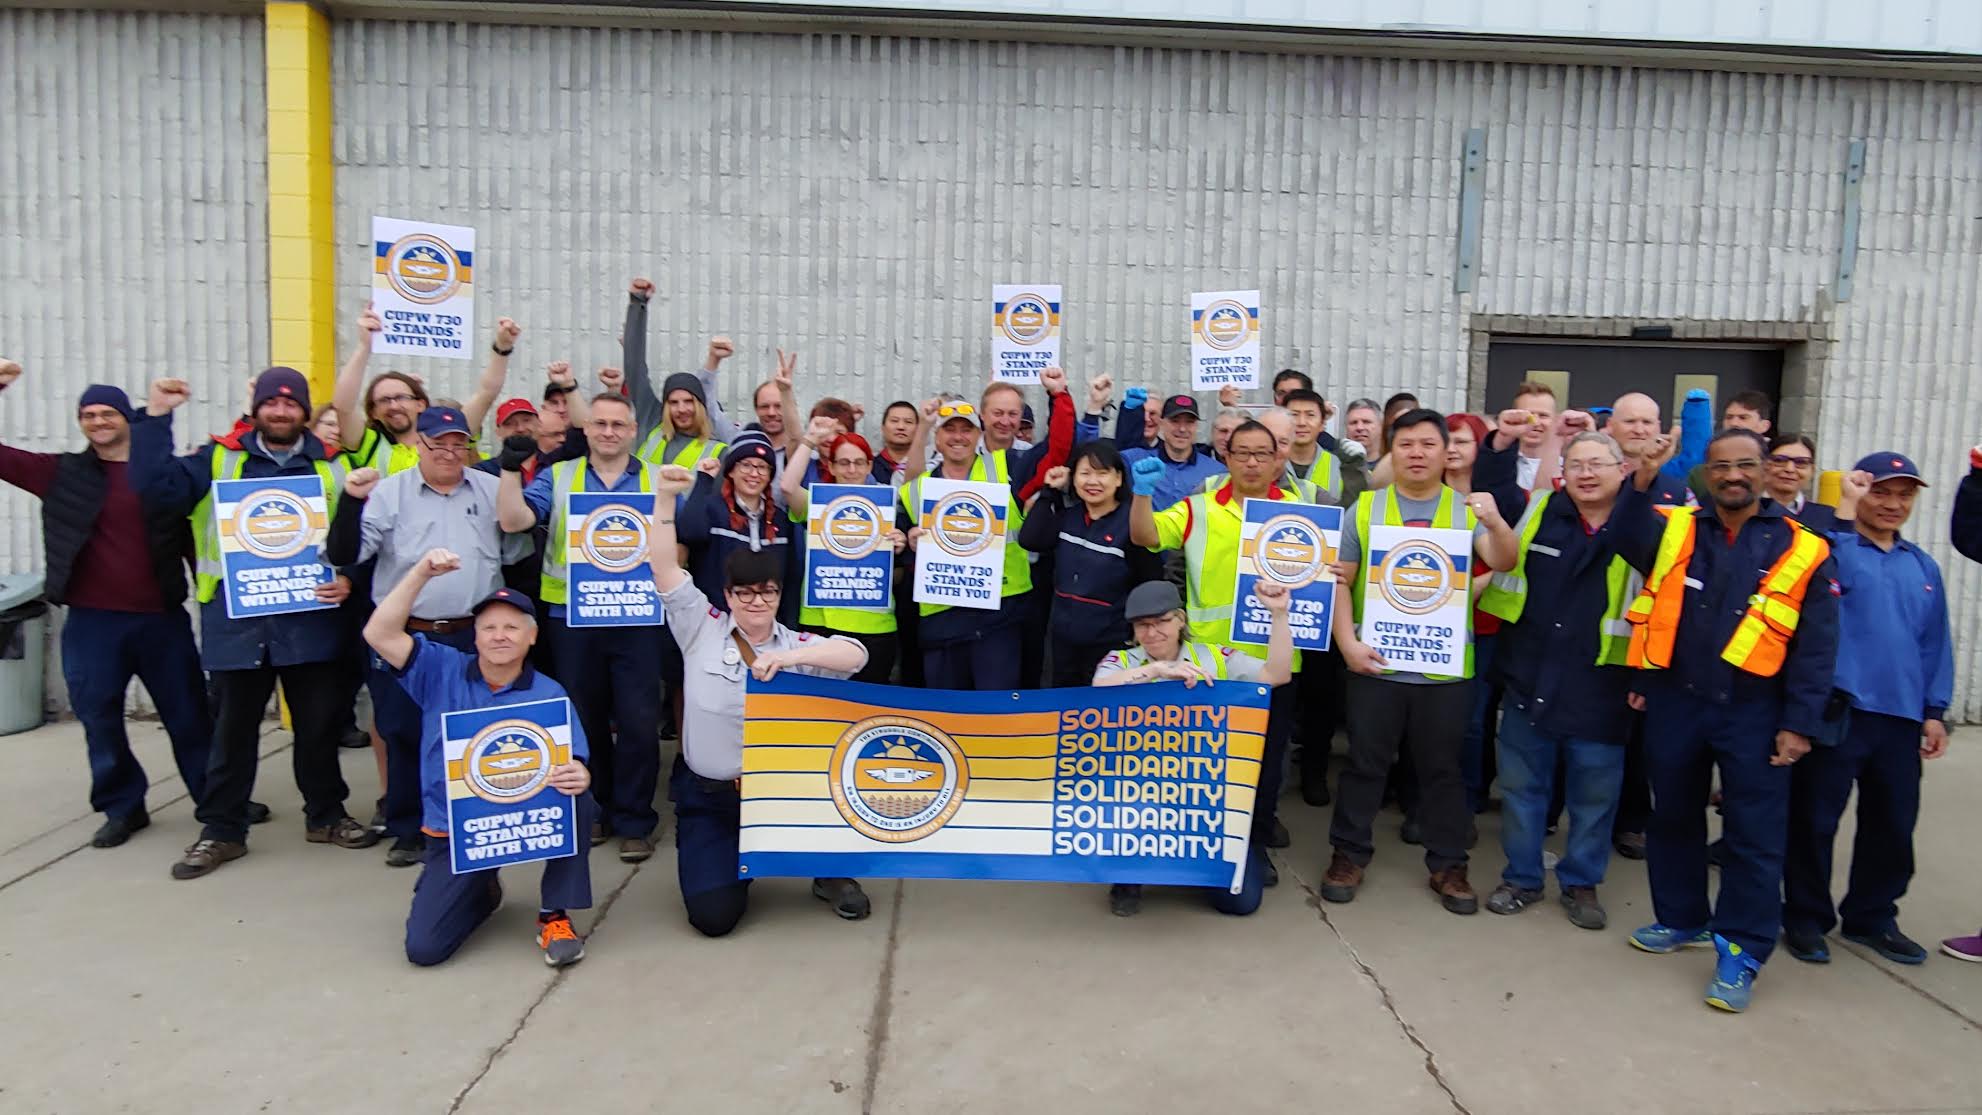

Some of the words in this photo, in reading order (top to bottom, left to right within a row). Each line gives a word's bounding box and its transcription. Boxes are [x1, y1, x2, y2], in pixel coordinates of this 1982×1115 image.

[384, 310, 431, 323] CUPW
[436, 315, 462, 326] 730
[392, 323, 453, 337] STANDS
[384, 334, 427, 346] WITH
[432, 338, 461, 349] YOU
[1200, 357, 1231, 365] CUPW
[1234, 356, 1252, 364] 730
[1206, 365, 1247, 374] STANDS
[1200, 375, 1229, 383] WITH
[1232, 374, 1252, 382] YOU
[236, 566, 290, 582] CUPW
[292, 563, 324, 576] 730
[815, 566, 857, 578] CUPW
[859, 567, 884, 578] 730
[926, 562, 966, 574] CUPW
[970, 566, 993, 576] 730
[247, 577, 316, 594] STANDS
[578, 581, 625, 592] CUPW
[627, 581, 655, 592] 730
[822, 578, 876, 589] STANDS
[932, 574, 985, 587] STANDS
[238, 592, 290, 607] WITH
[291, 589, 317, 602] YO
[586, 593, 647, 605] STANDS
[814, 588, 853, 600] WITH
[855, 589, 883, 600] YOU
[925, 585, 961, 597] WITH
[965, 588, 991, 599] YOU
[578, 605, 622, 617] WITH
[624, 605, 655, 616] YOU
[1295, 599, 1324, 614] 730
[1288, 626, 1321, 640] YOU
[1374, 621, 1420, 635] CUPW
[1425, 625, 1453, 638] 730
[1381, 635, 1444, 650] STANDS
[1420, 651, 1452, 664] YOU
[1061, 705, 1226, 731] SOLIDARITY
[1060, 730, 1225, 754] SOLIDARITY
[1058, 755, 1224, 780] SOLIDARITY
[1056, 779, 1223, 807] SOLIDARITY
[463, 812, 525, 833] CUPW
[527, 806, 563, 823] 730
[1055, 804, 1222, 833] SOLIDARITY
[474, 822, 554, 846] STANDS
[465, 840, 522, 862] WITH
[525, 834, 564, 852] YOU
[1054, 831, 1222, 860] SOLIDARITY
